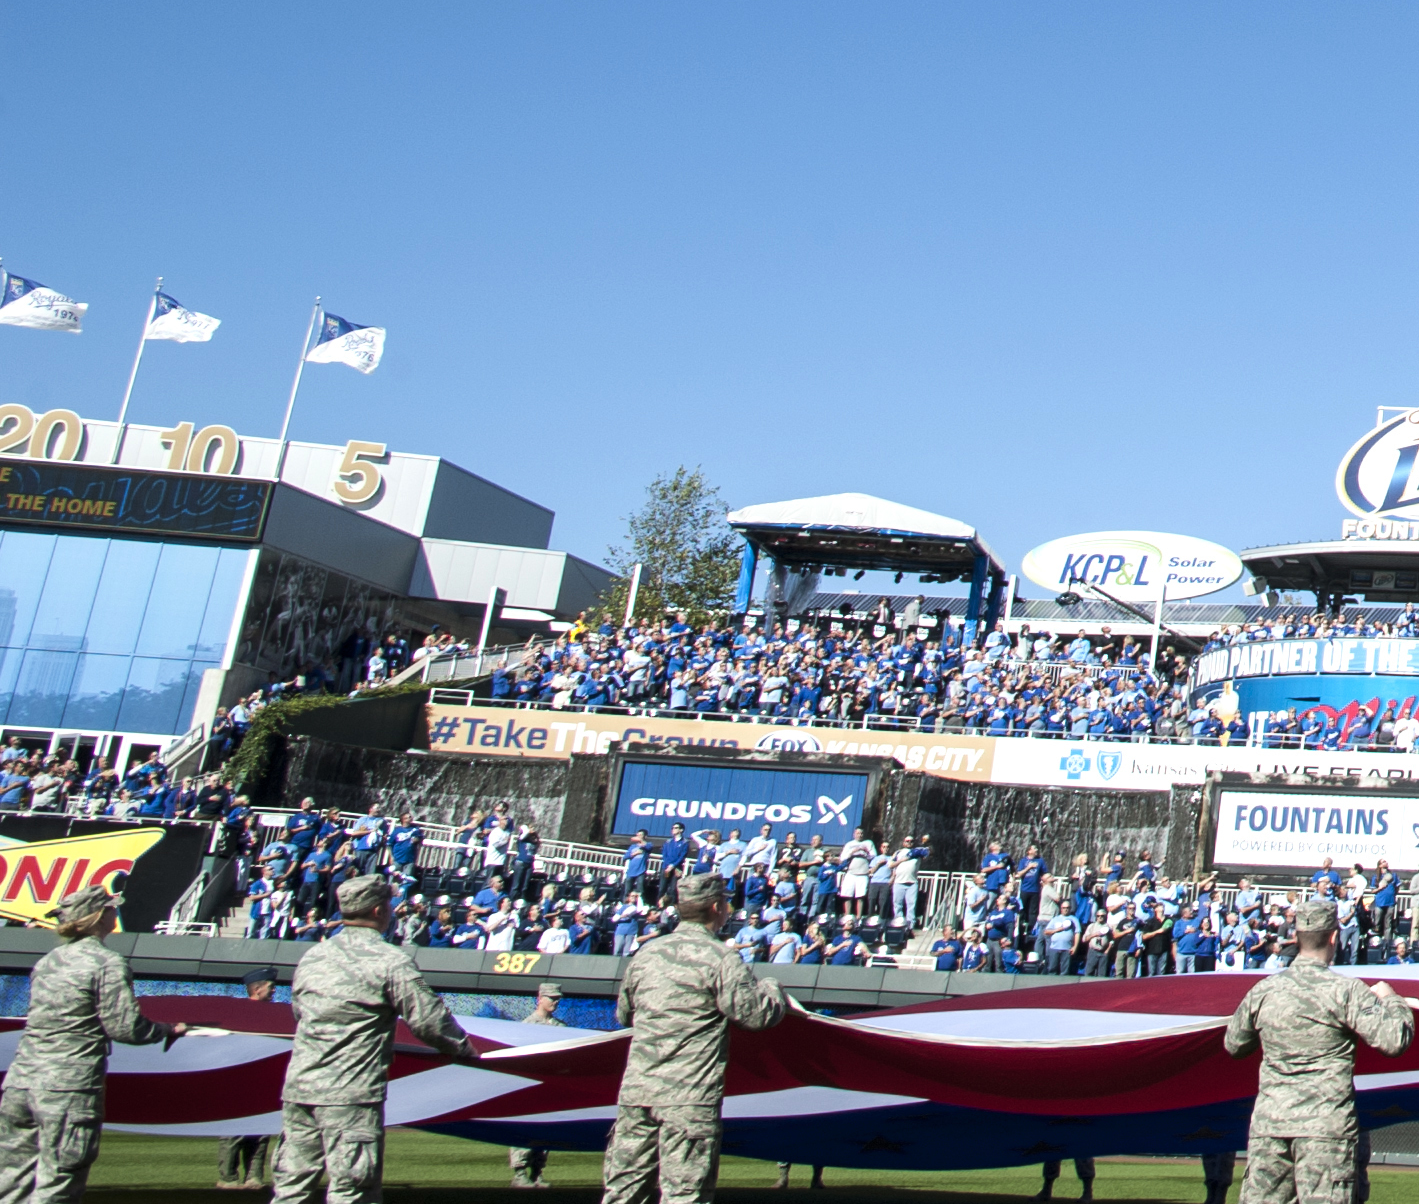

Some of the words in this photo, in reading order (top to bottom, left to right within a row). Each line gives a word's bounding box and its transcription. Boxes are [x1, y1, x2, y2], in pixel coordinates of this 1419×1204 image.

[0, 403, 84, 461] 20
[160, 421, 240, 475] 10
[334, 439, 387, 504] 5
[7, 493, 46, 511] THE
[51, 497, 117, 517] HOME
[1058, 553, 1149, 586] KCP&L
[1168, 556, 1216, 568] Solar
[1166, 573, 1224, 584] Power
[1228, 642, 1317, 678] PARTNER
[1322, 641, 1354, 672] OF
[1362, 641, 1419, 672] THE
[925, 746, 984, 772] CITY
[630, 797, 812, 823] GRUNDFOS
[1234, 804, 1389, 836] FOUNTAINS
[1232, 840, 1294, 852] POWERED
[1298, 841, 1313, 853] BY
[1317, 842, 1387, 855] GRUNDFOS
[0, 854, 136, 904] NIC
[493, 952, 541, 974] 387
